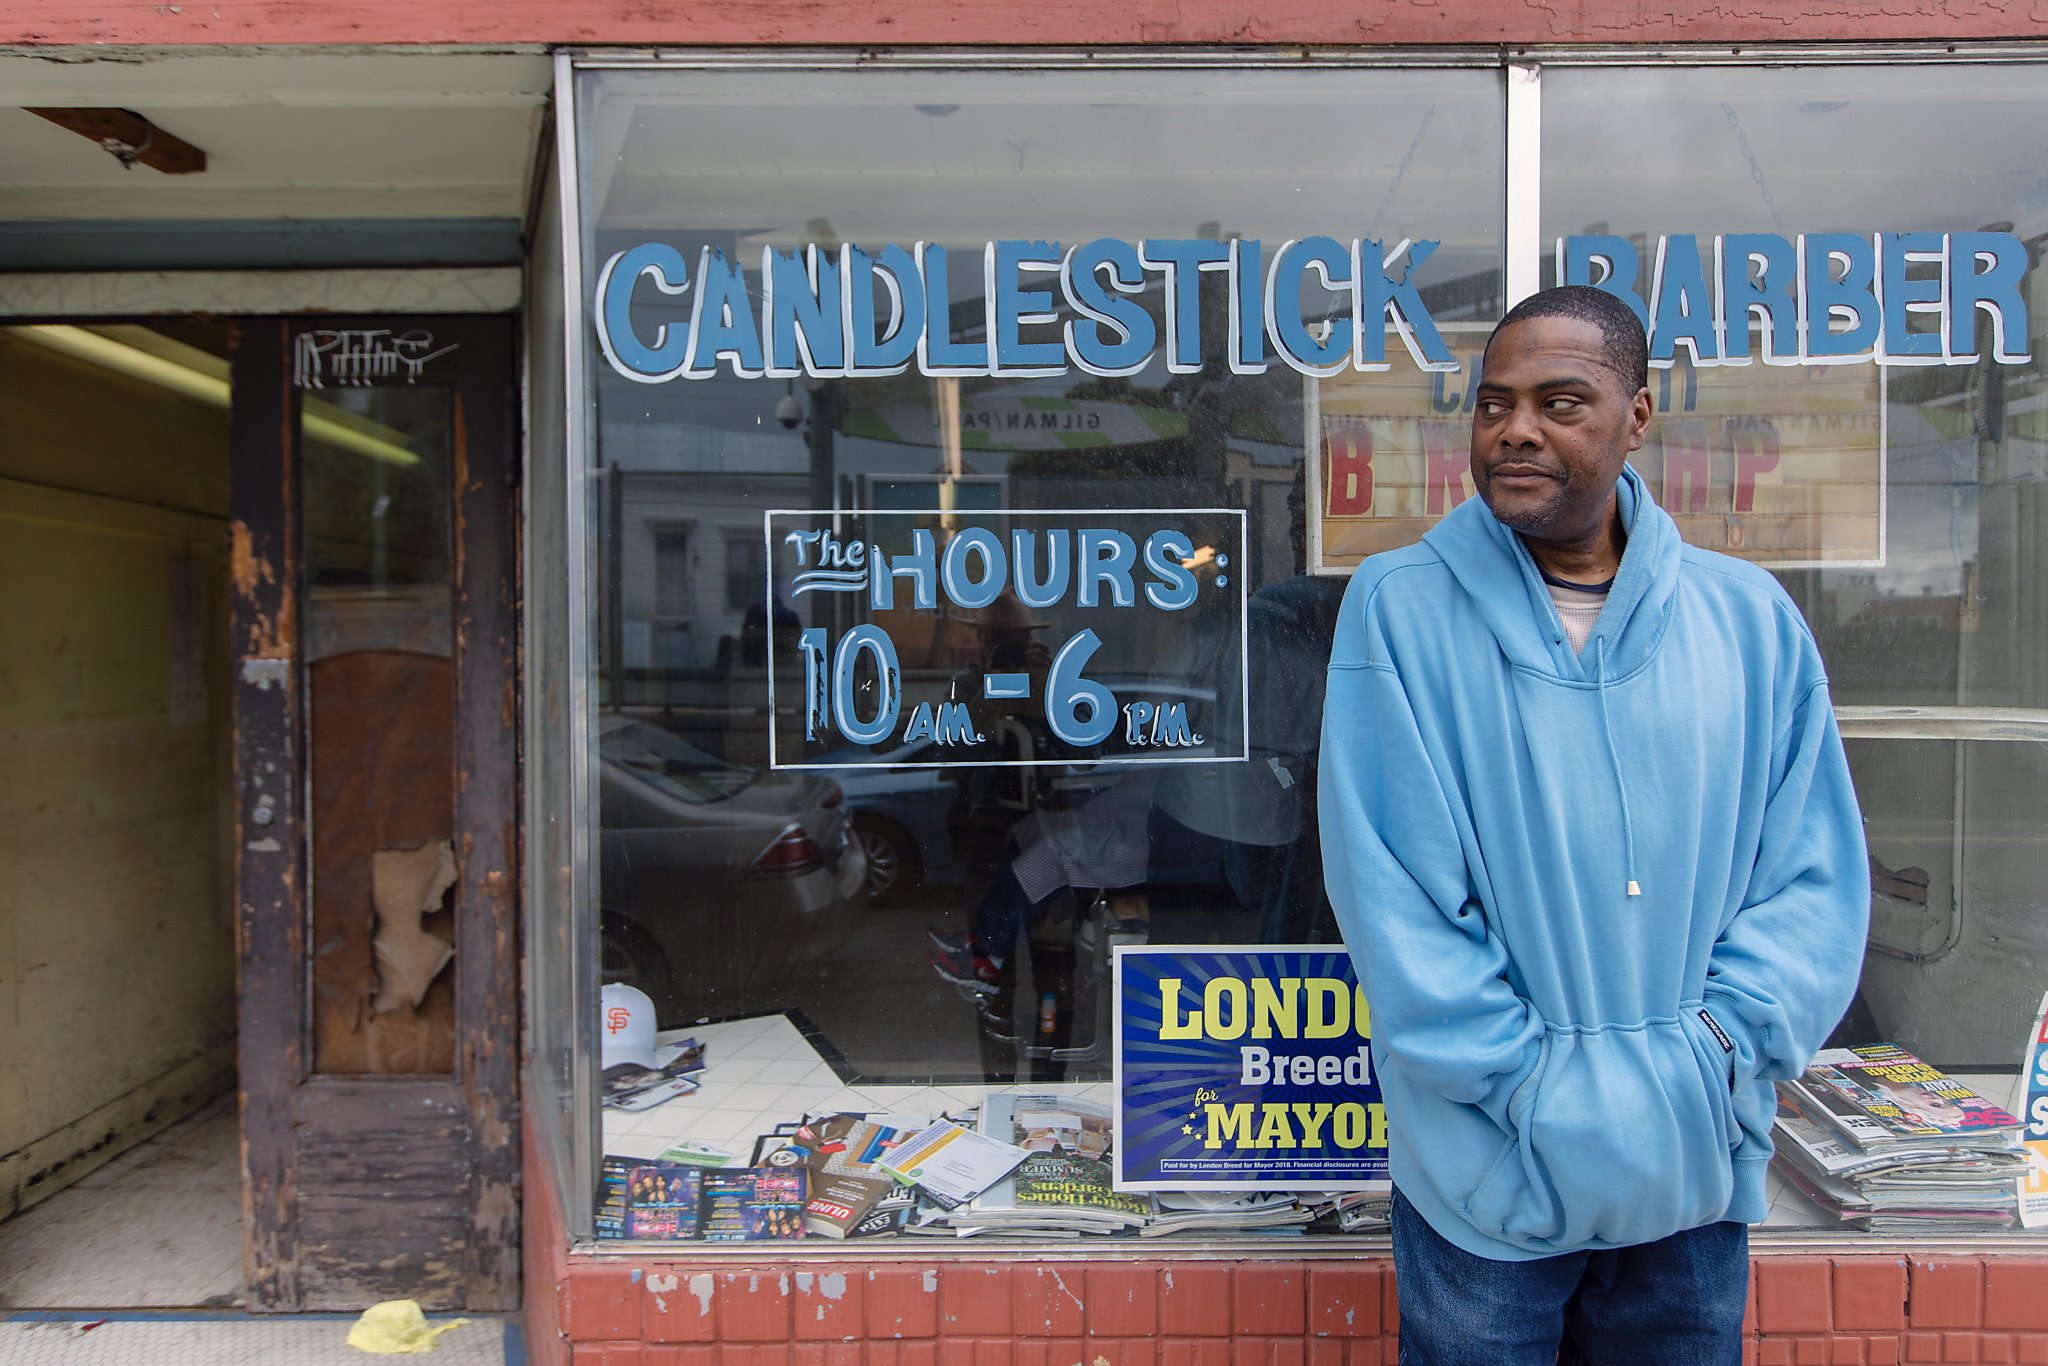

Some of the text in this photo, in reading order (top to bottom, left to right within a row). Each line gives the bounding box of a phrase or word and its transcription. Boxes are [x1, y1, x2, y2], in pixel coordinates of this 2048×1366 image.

[596, 238, 1460, 383] CANDLESTICK
[784, 528, 868, 568] The
[797, 623, 901, 746] 10
[1044, 627, 1119, 746] 6
[1158, 976, 1371, 1040] LOND
[1240, 1046, 1371, 1086] Breed
[1194, 1087, 1219, 1107] for
[1163, 1161, 1178, 1169] Paid
[1198, 1161, 1223, 1169] London
[1223, 1161, 1243, 1169] Breed
[1254, 1161, 1273, 1171] Mayor
[1275, 1161, 1293, 1169] 2018.
[1293, 1161, 1322, 1169] Financial
[1017, 1192, 1086, 1205] Homes
[1031, 1182, 1113, 1199] Gardens
[807, 1201, 850, 1219] ULINE
